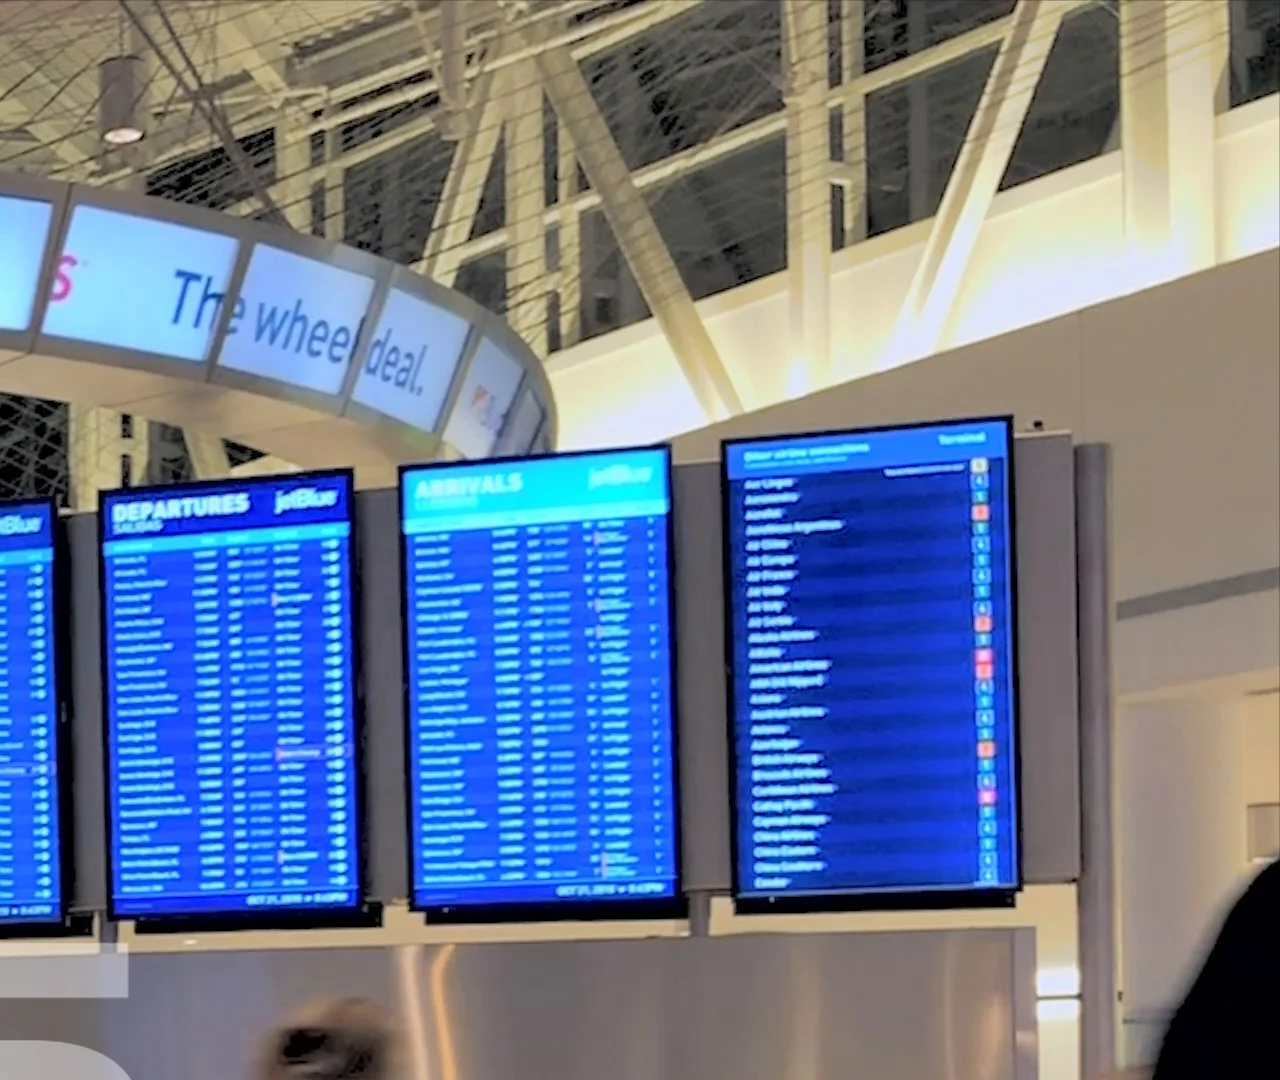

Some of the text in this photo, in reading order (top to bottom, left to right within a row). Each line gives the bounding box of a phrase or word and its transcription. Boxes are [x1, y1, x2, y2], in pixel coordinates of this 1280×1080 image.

[172, 267, 243, 338] The
[252, 297, 366, 370] wheel
[413, 471, 524, 500] ARRIVALS
[112, 486, 339, 523] DEPARTURES jetBlue
